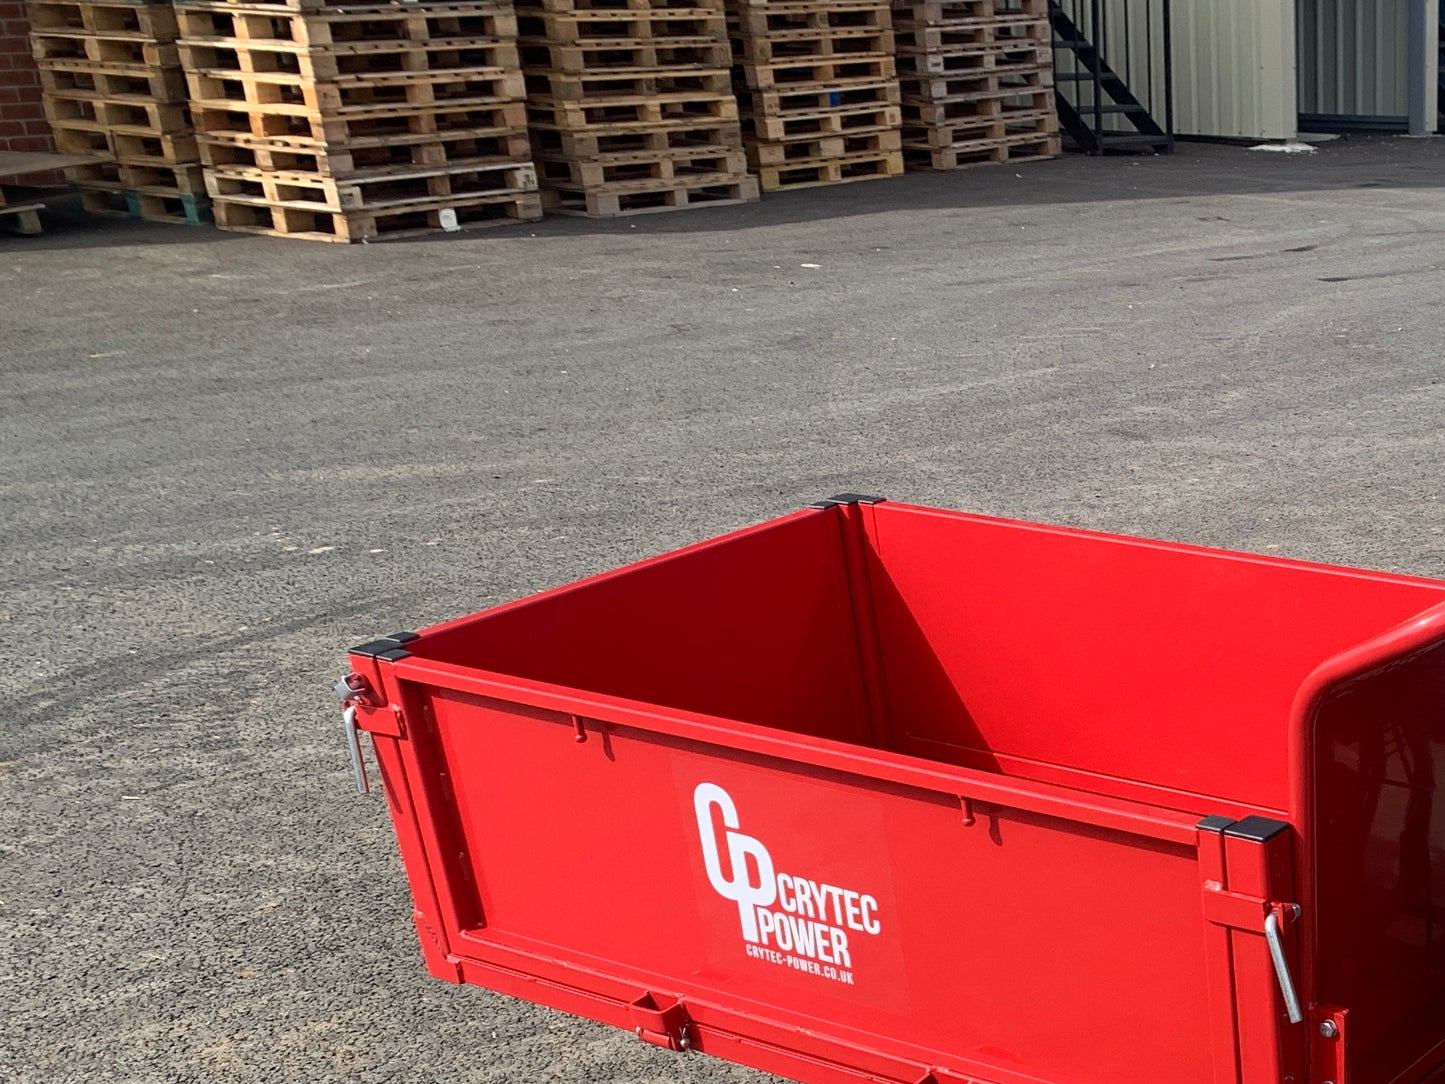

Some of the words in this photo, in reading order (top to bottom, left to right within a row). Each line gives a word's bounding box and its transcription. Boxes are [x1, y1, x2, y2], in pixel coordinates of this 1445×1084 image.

[776, 872, 881, 935] CRYTEC
[745, 944, 855, 986] CRYTEC-POWER.CO.UK
[756, 906, 852, 969] POWER
